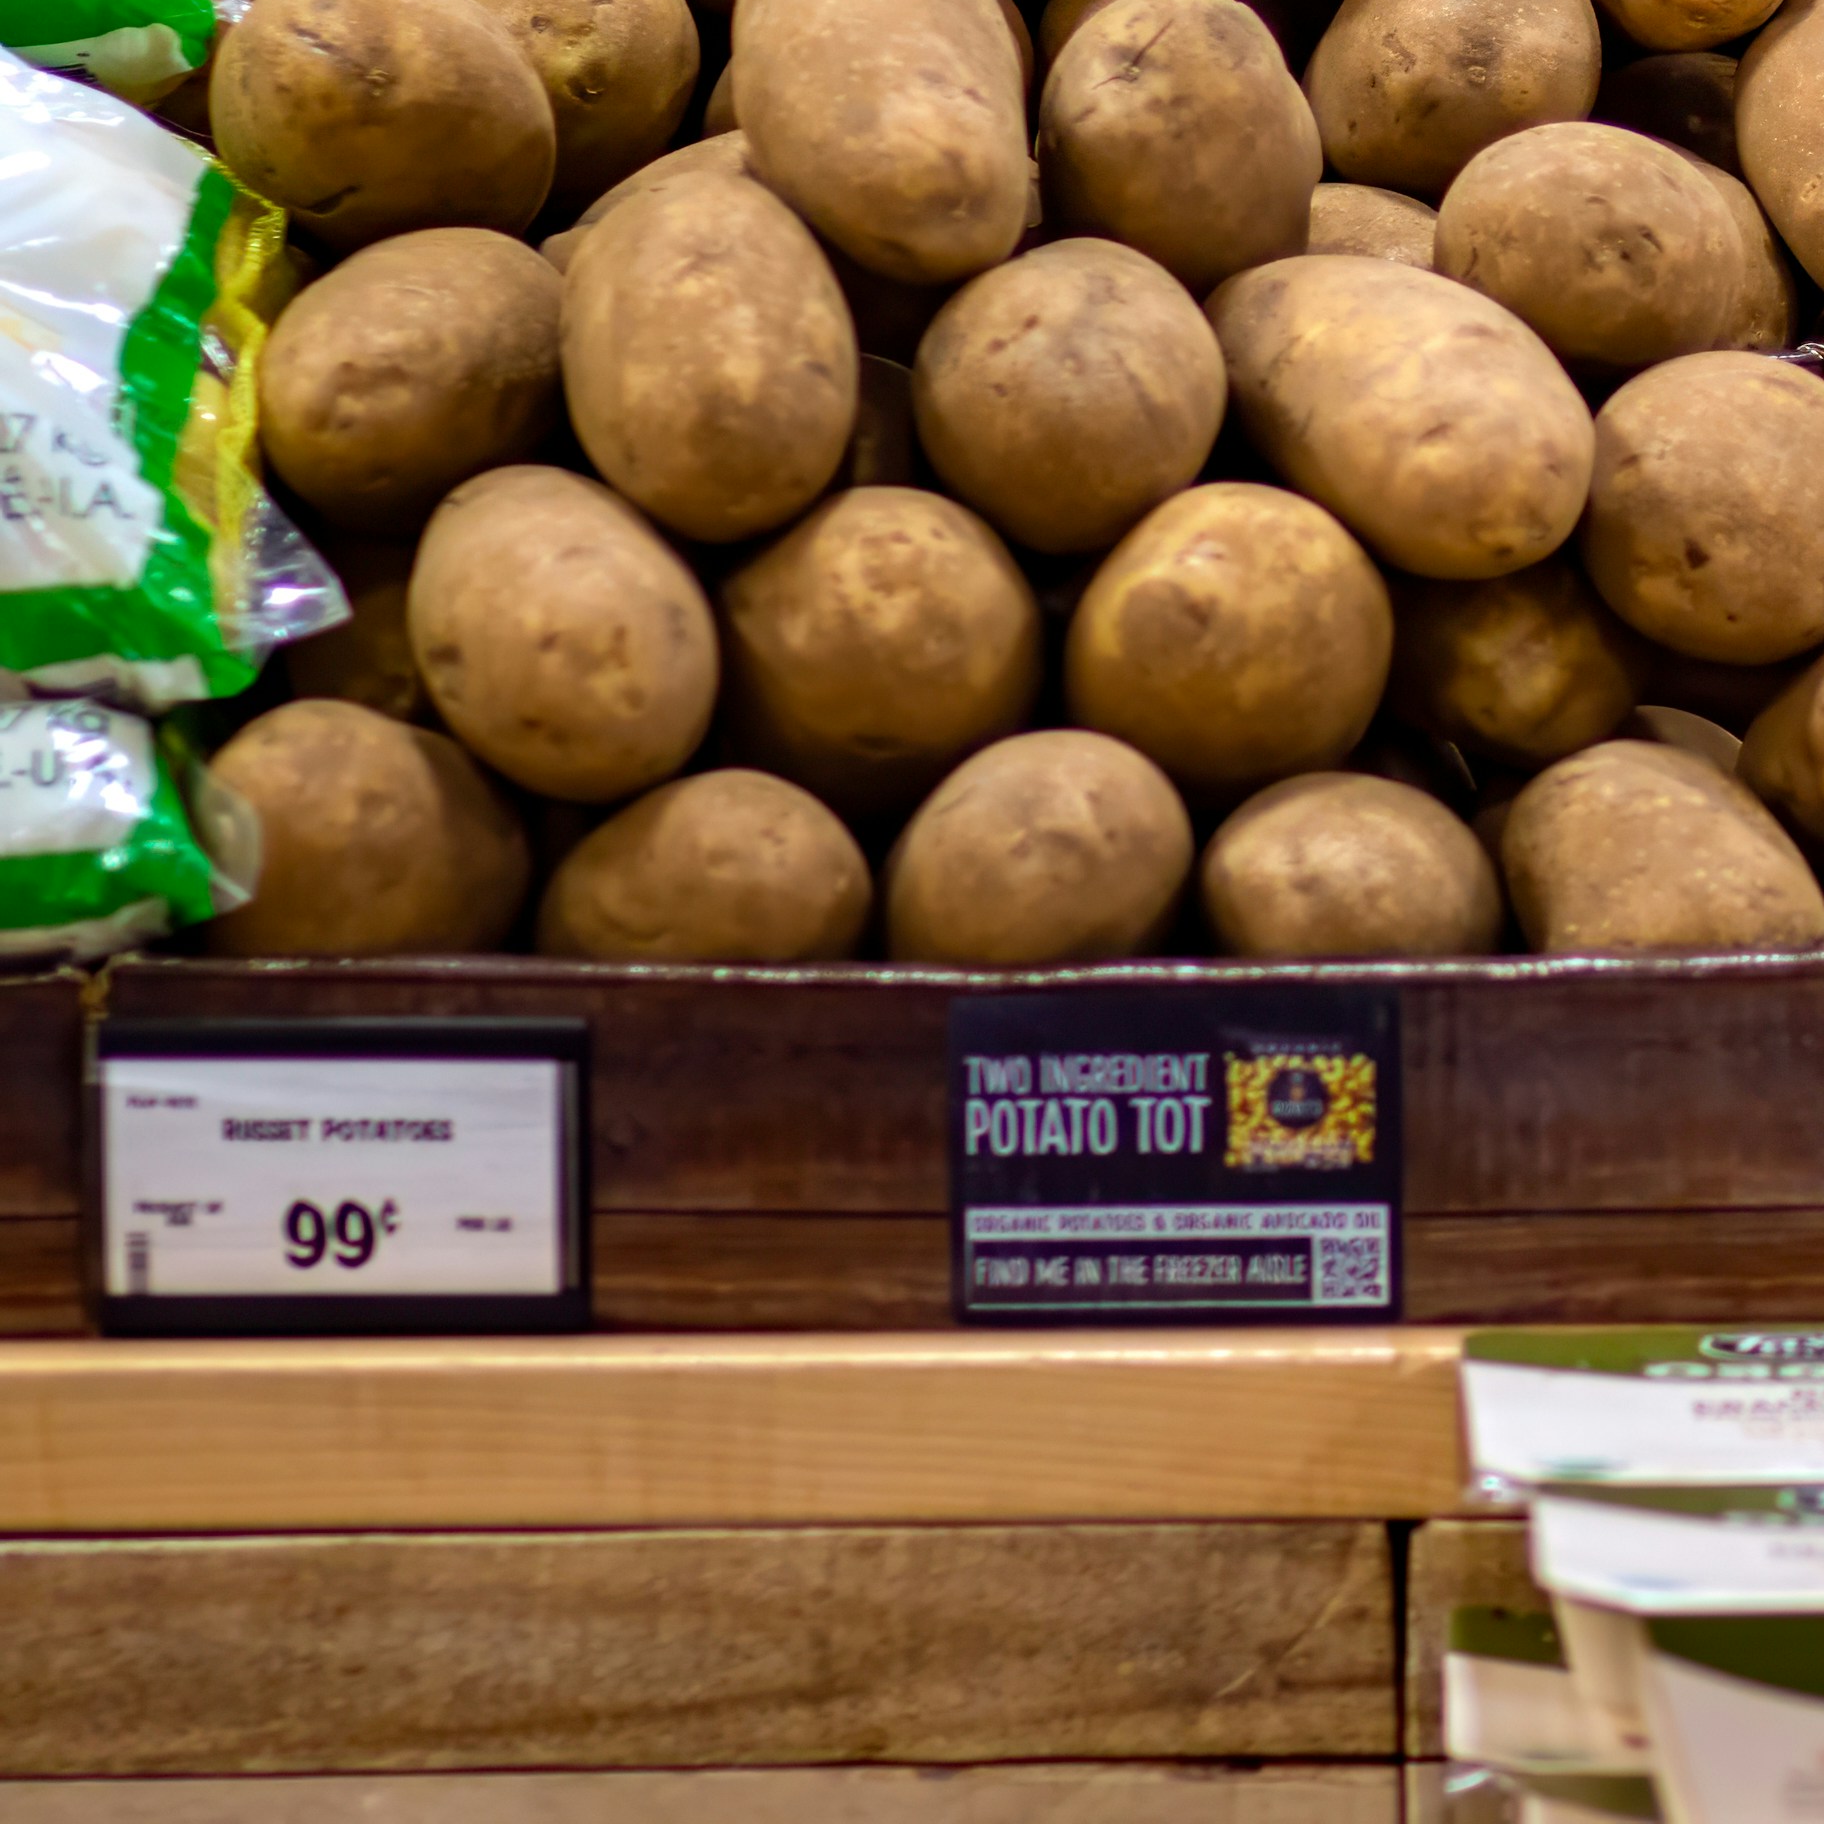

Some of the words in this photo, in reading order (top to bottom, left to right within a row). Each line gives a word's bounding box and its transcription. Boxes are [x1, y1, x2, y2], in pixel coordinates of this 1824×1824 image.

[964, 1055, 1032, 1095] TWO
[1040, 1053, 1209, 1093] INGREDIENT
[321, 1119, 454, 1141] POTATOES
[966, 1098, 1118, 1156] POTATO
[1128, 1096, 1211, 1154] TOT
